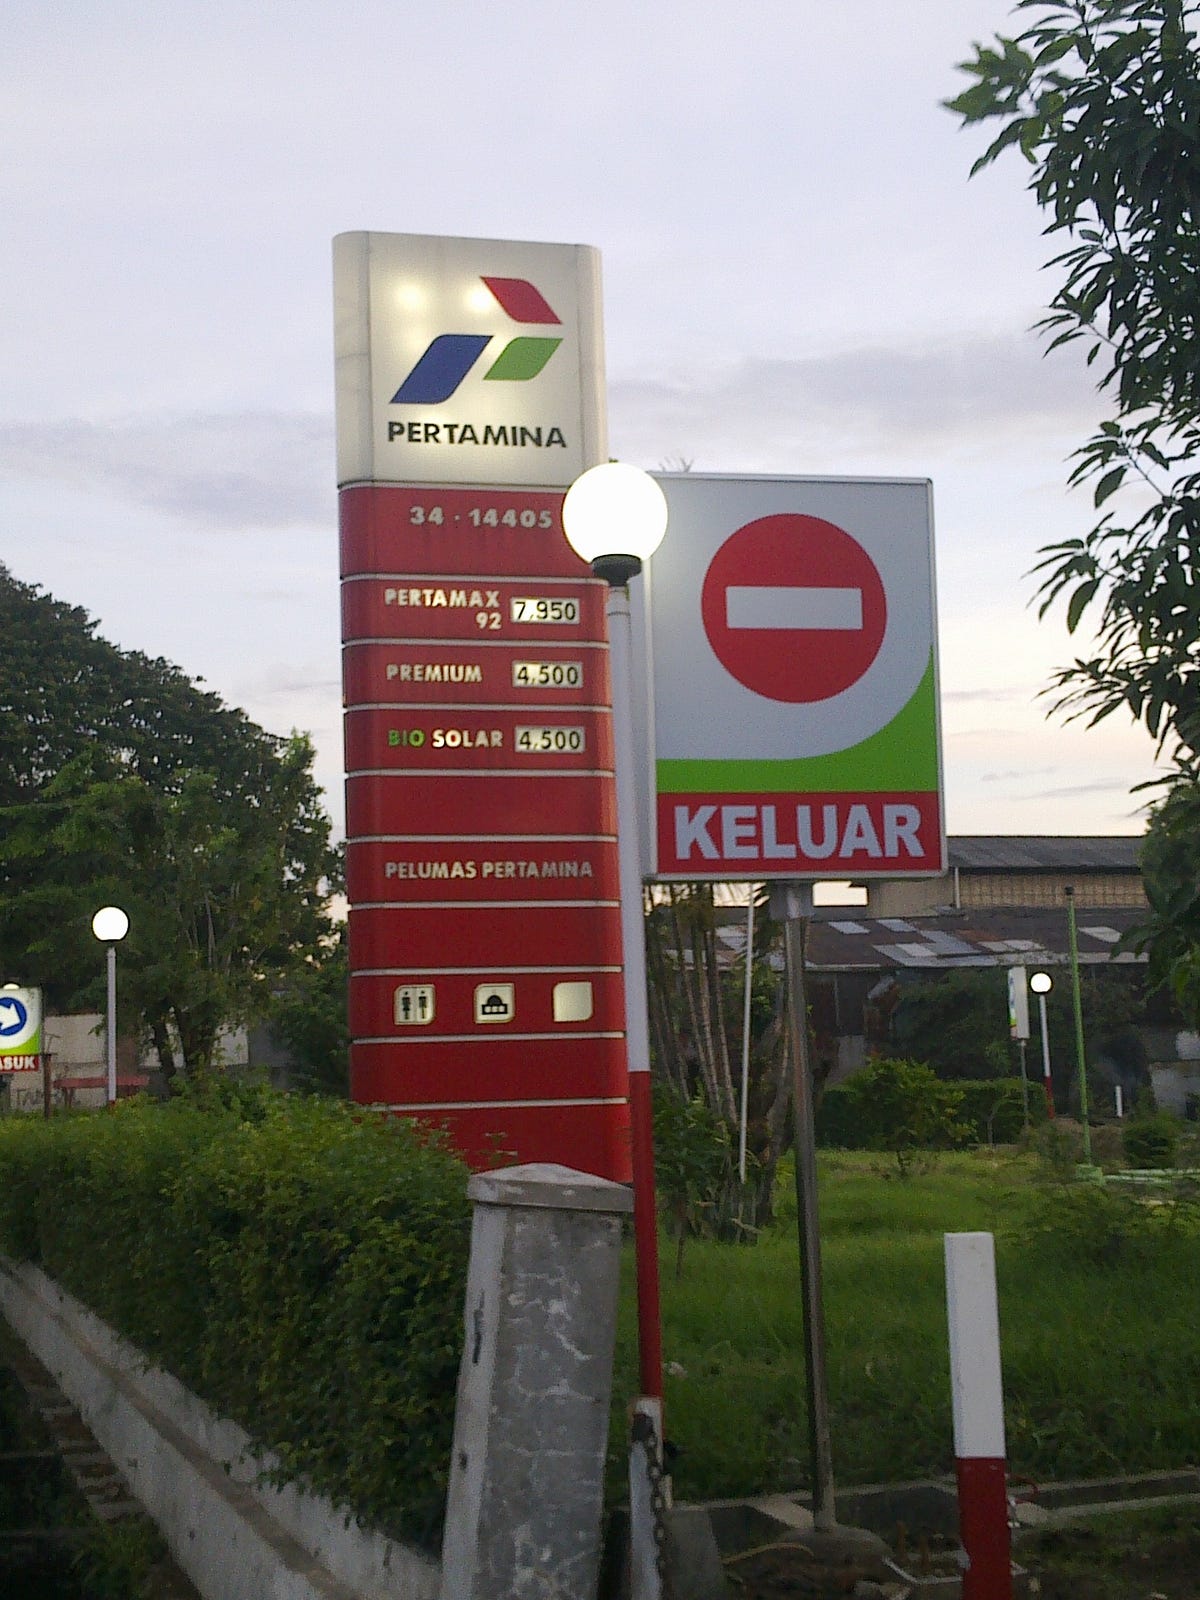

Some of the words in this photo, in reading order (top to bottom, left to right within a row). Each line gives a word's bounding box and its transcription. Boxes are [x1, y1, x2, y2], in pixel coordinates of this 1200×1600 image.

[388, 420, 567, 448] PERTAMINA
[409, 506, 444, 526] 34
[468, 508, 553, 528] 14405
[384, 588, 500, 609] PERTAMAX
[514, 601, 577, 621] 7,950
[476, 612, 502, 630] 92
[386, 663, 483, 683] PREMIUM
[516, 665, 579, 686] 4,500
[388, 729, 425, 747] BIO
[432, 729, 503, 748] SOLAR
[519, 730, 581, 751] 4,500
[674, 804, 926, 860] KELUAR
[385, 861, 477, 880] PELUMAS
[482, 861, 593, 879] PERTAMINA
